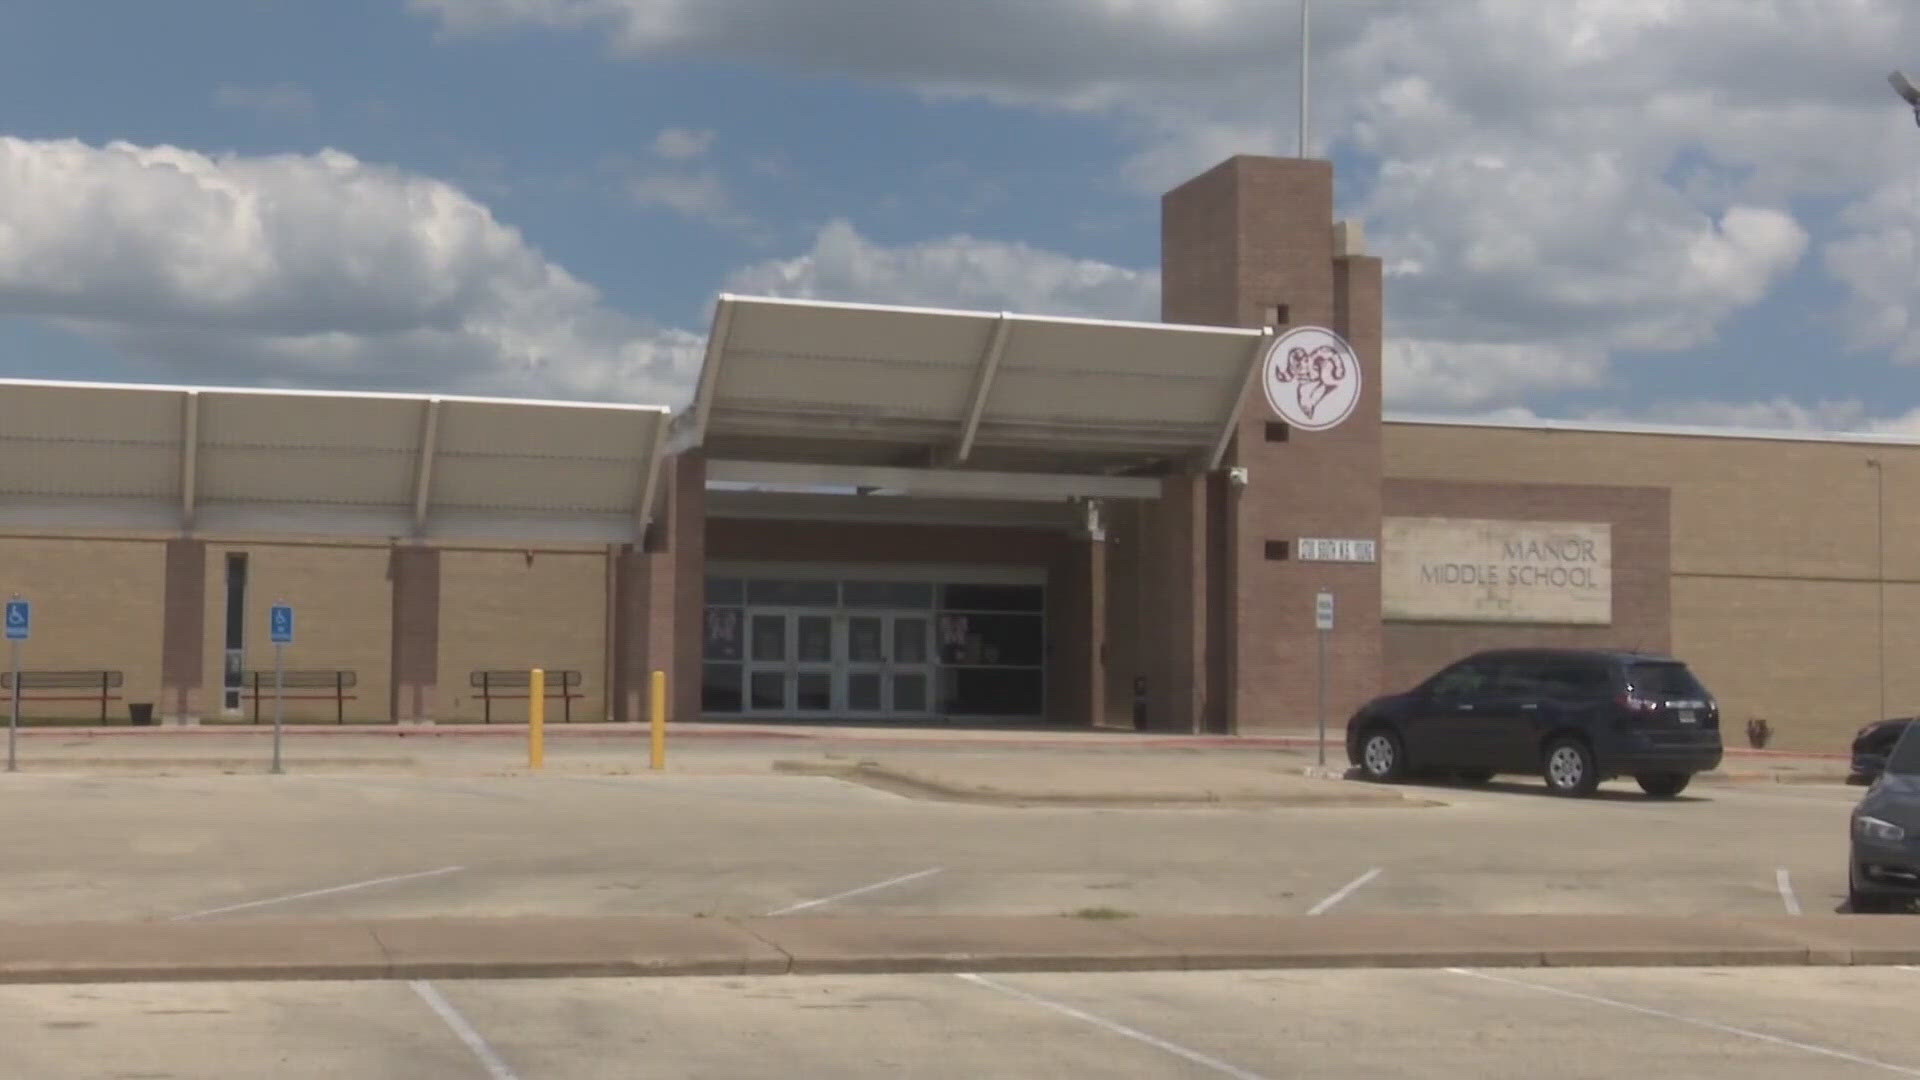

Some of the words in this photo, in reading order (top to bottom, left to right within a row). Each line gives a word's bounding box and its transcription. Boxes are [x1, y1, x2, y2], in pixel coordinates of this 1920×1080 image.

[1502, 540, 1598, 562] MANOR
[1420, 563, 1498, 585] MIDDLE
[1507, 566, 1598, 588] SCHOOL
